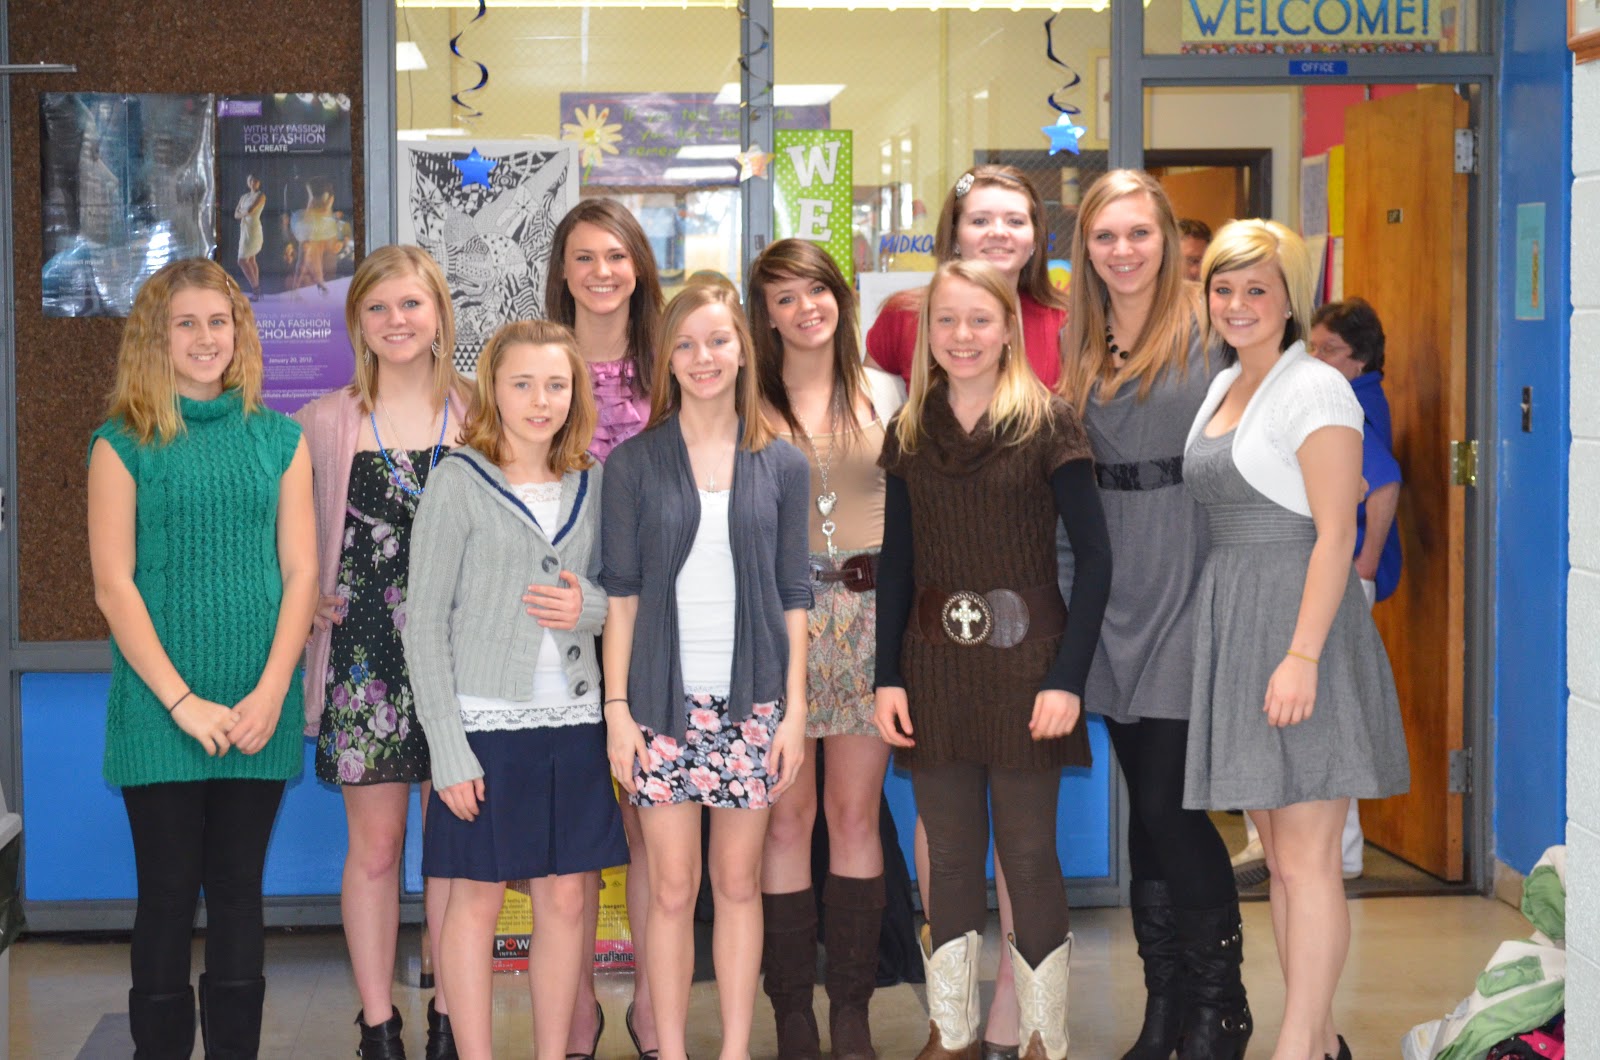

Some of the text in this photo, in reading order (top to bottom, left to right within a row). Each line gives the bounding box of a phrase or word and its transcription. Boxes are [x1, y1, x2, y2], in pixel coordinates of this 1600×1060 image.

[1189, 0, 1429, 37] WELCOME!
[1301, 62, 1335, 73] OFFICE
[243, 123, 326, 133] WITH MY PASSION
[244, 132, 326, 145] FOR FASHION
[259, 144, 288, 152] CREATE
[879, 234, 934, 255] MIDKO
[256, 318, 331, 328] ARN A FASHION
[257, 328, 332, 339] CHOLARSHIP
[594, 951, 633, 962] uraflame
